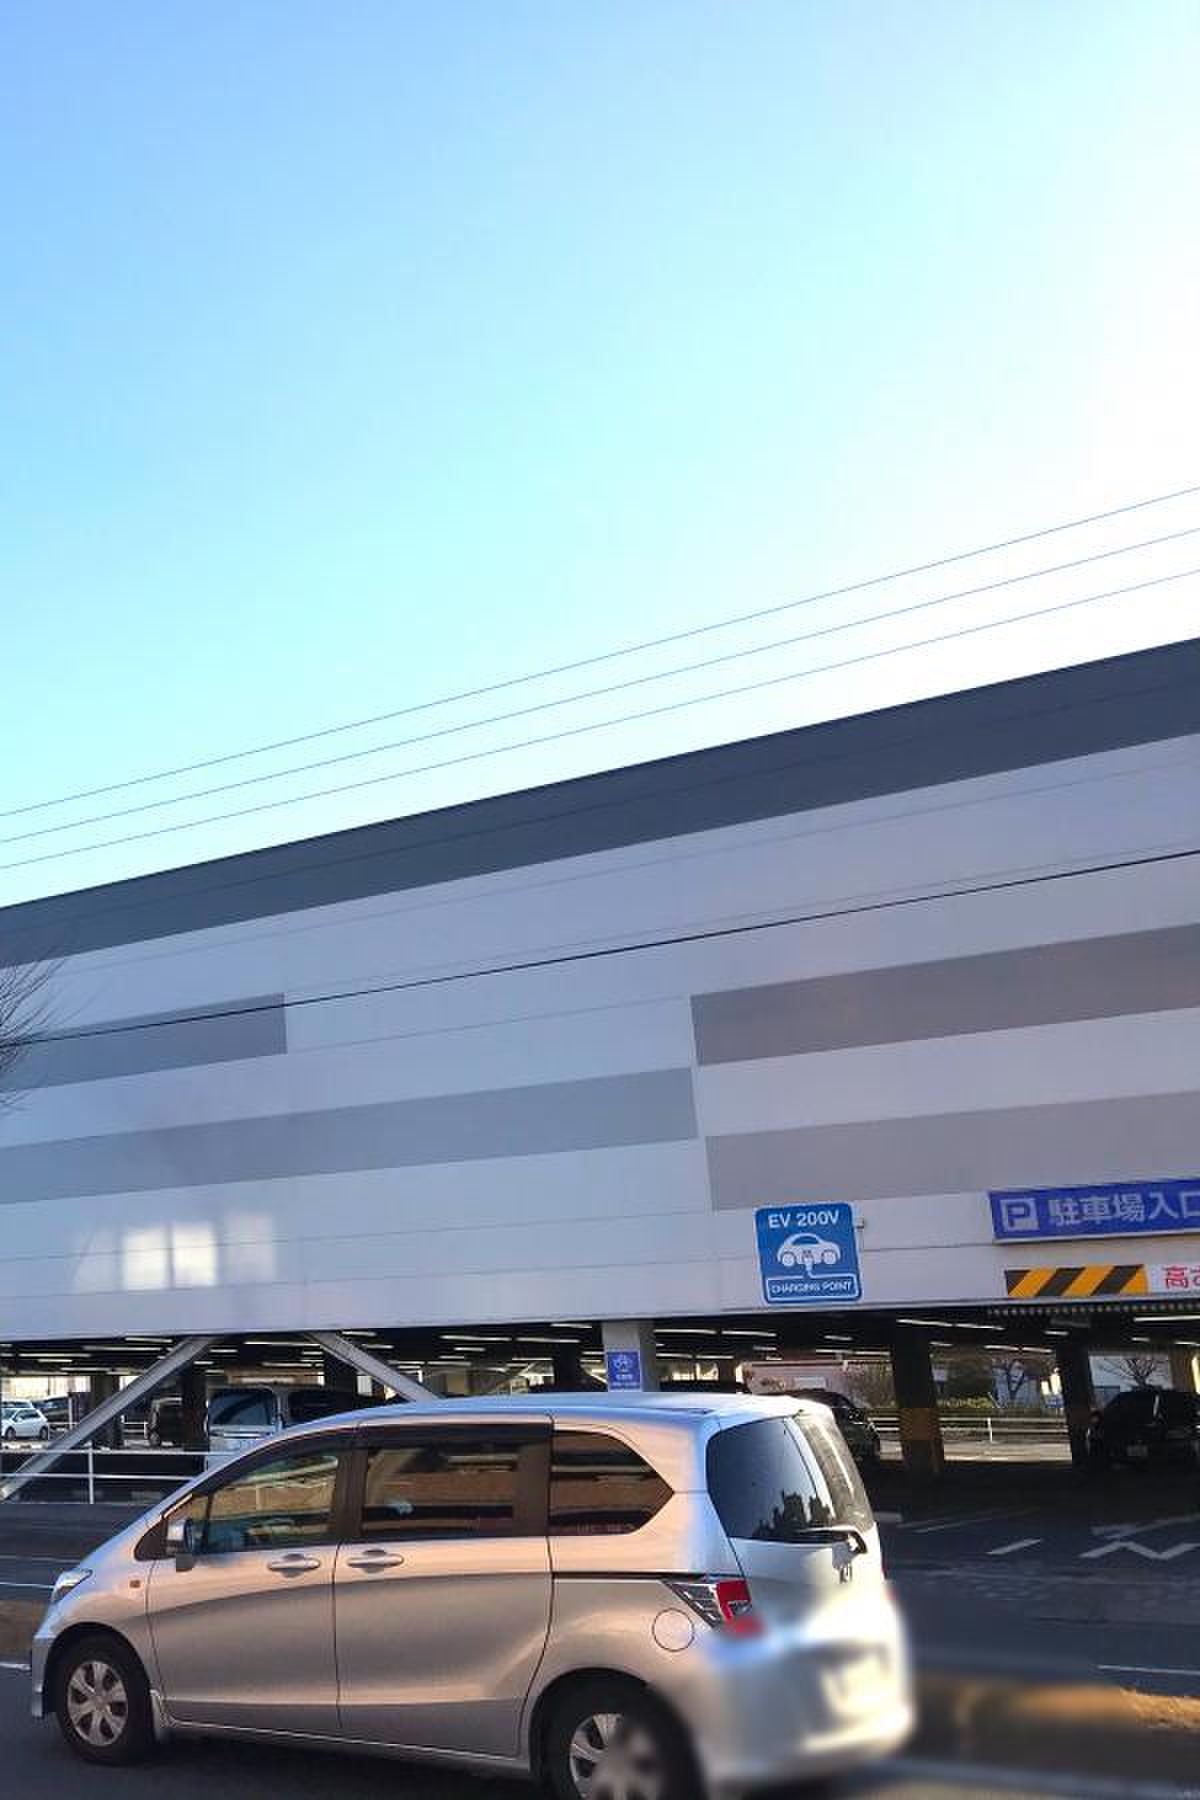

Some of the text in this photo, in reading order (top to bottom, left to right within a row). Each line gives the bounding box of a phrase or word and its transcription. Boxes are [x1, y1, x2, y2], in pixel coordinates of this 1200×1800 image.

[1049, 1191, 1200, 1226] 駐車場入口
[768, 1210, 839, 1228] EV 200V
[822, 1280, 852, 1293] POINT
